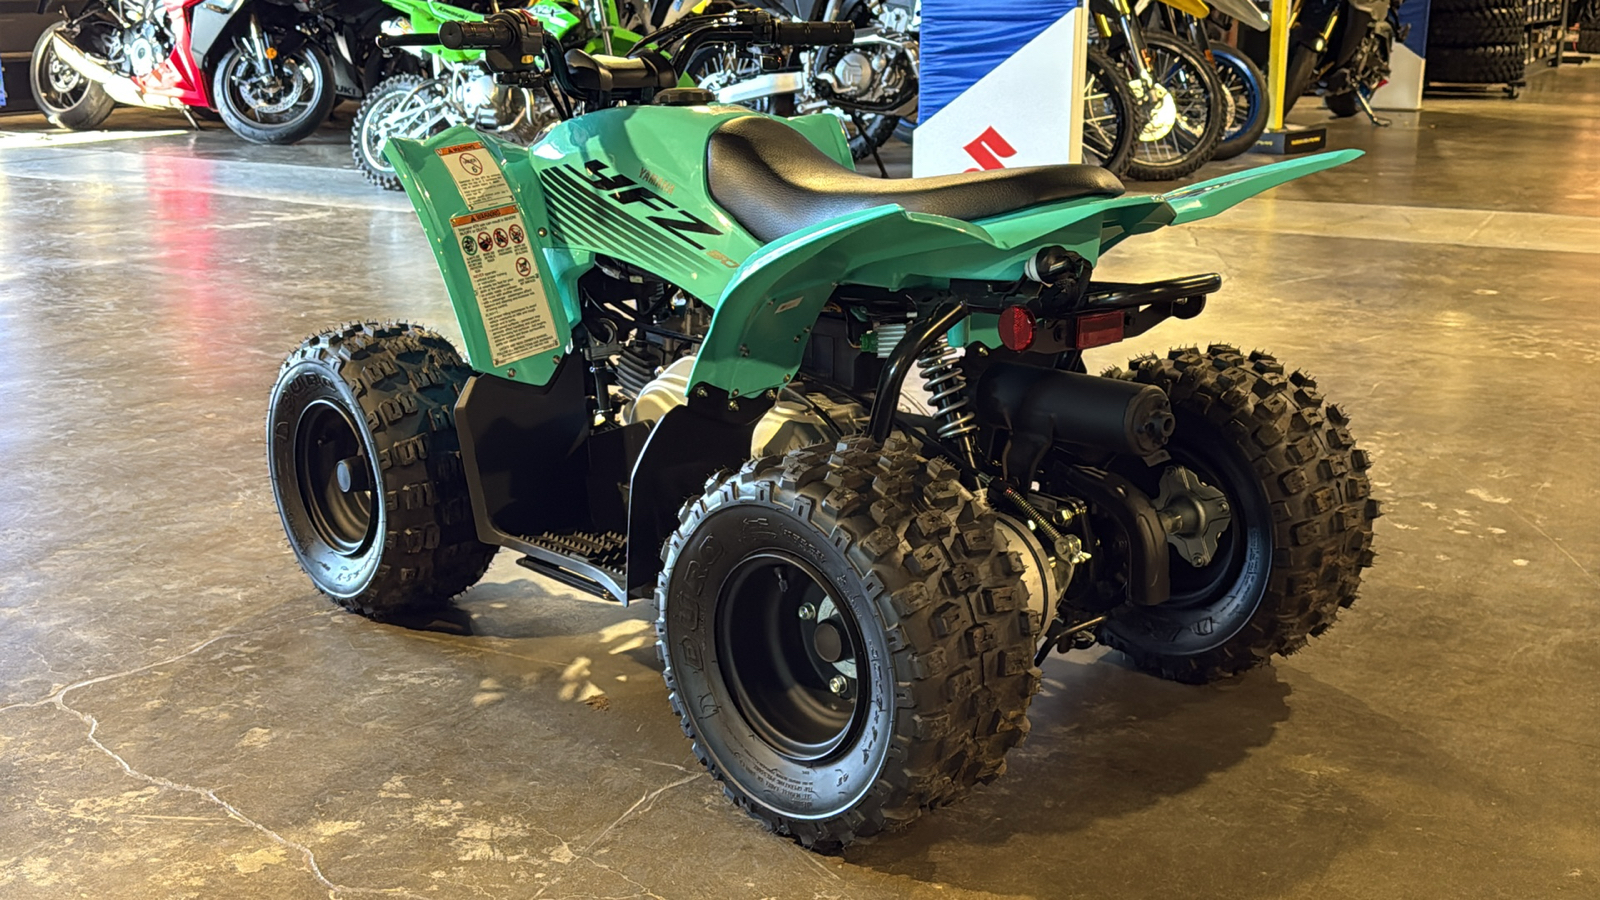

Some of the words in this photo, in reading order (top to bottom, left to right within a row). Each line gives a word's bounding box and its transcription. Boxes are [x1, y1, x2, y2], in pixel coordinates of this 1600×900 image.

[584, 159, 724, 250] YFZ
[638, 166, 676, 196] YAMAHA
[477, 210, 500, 220] WARNING
[677, 533, 725, 672] DURO
